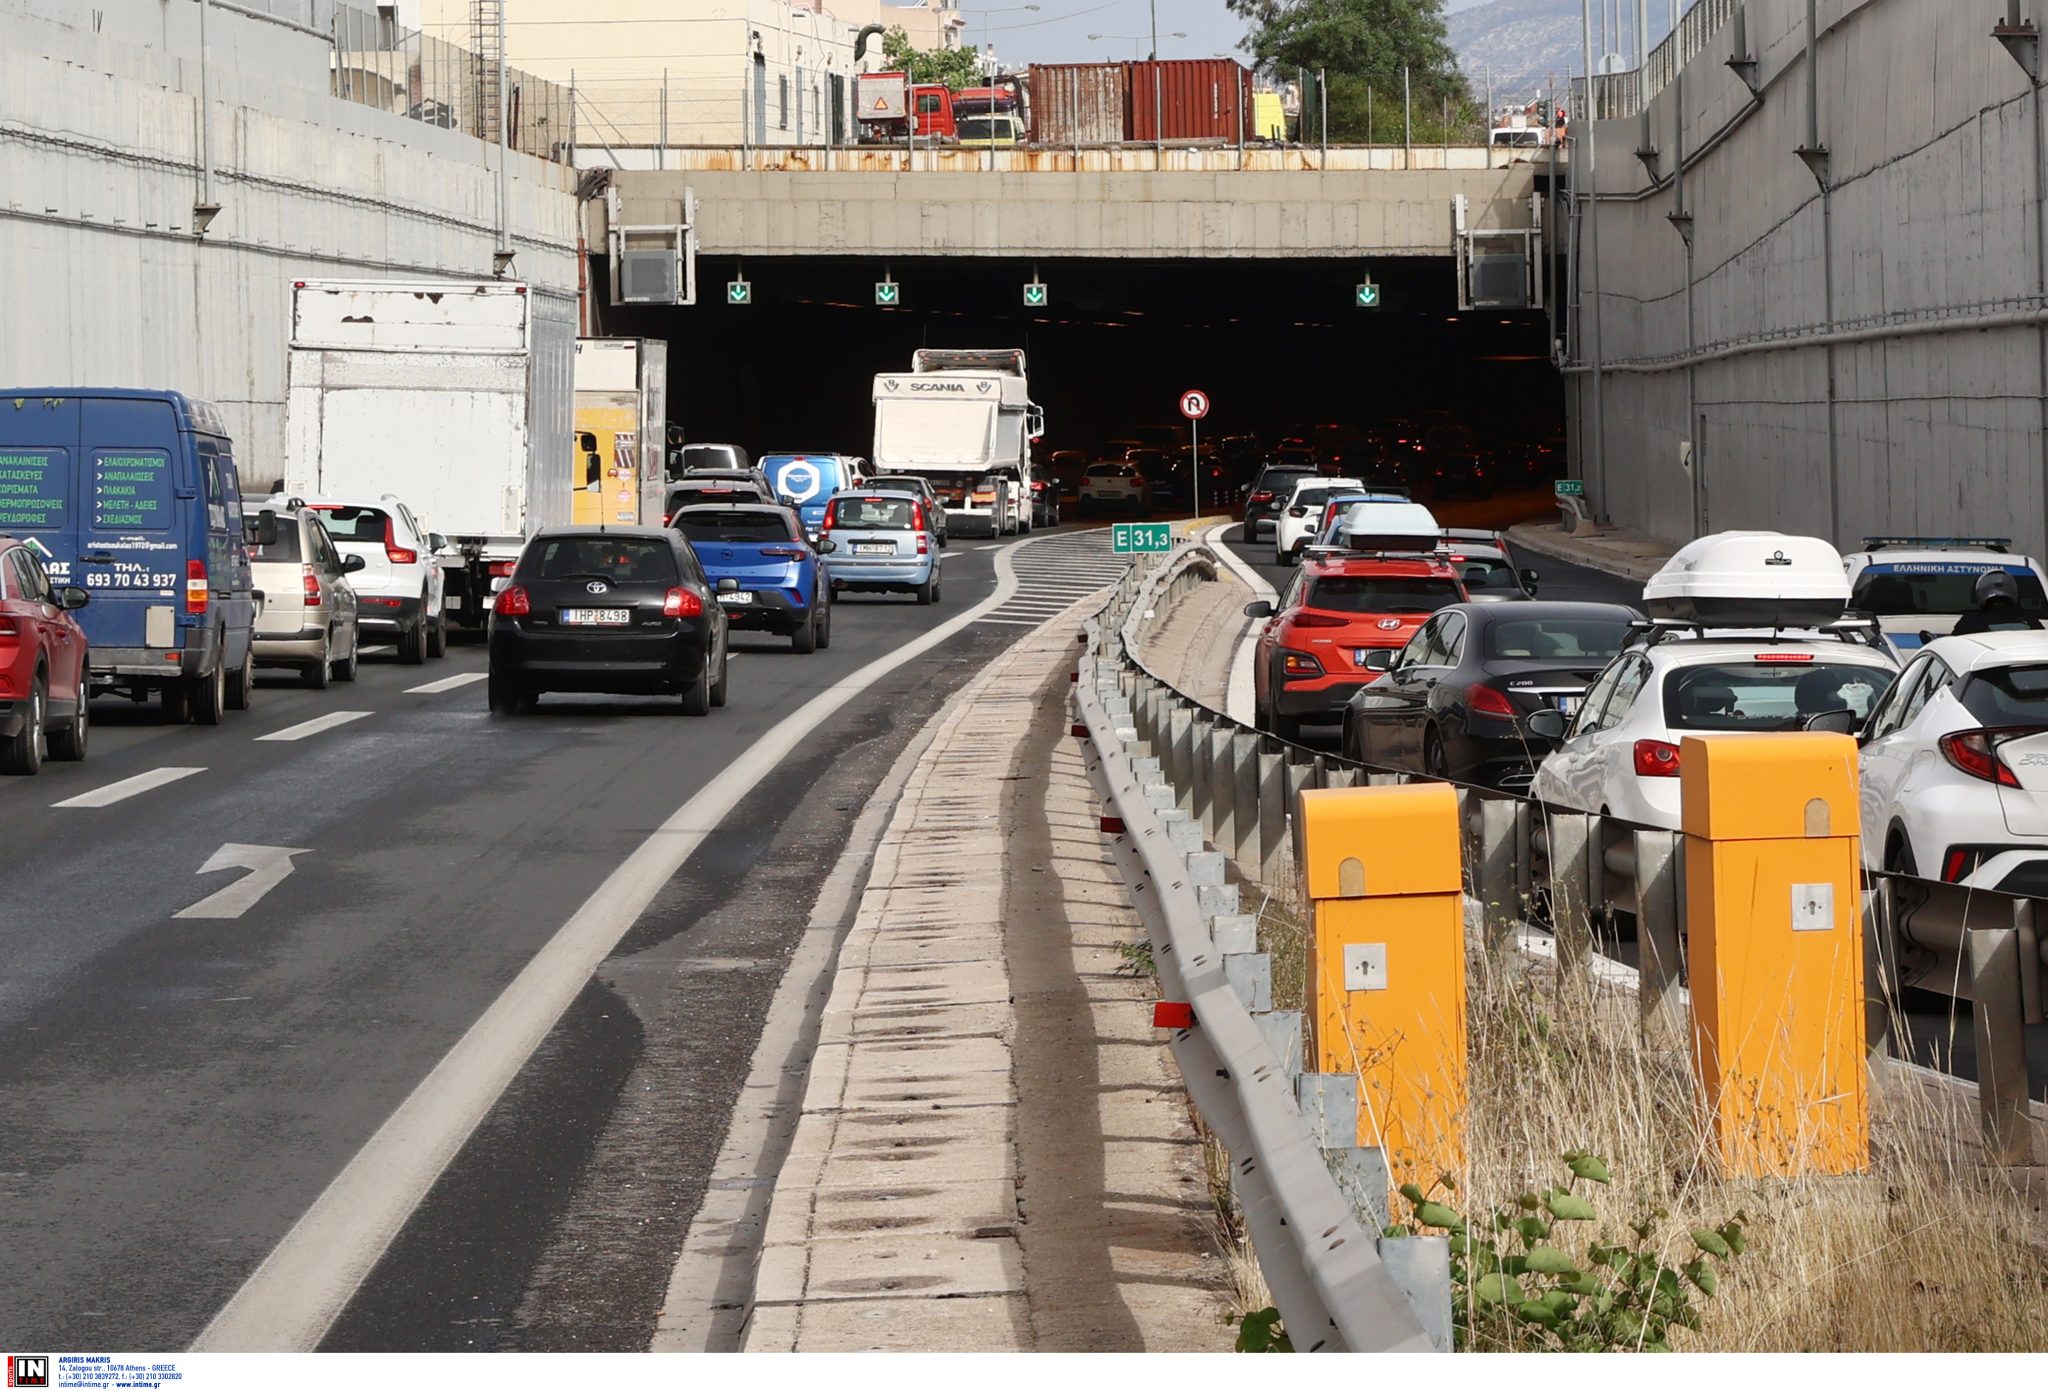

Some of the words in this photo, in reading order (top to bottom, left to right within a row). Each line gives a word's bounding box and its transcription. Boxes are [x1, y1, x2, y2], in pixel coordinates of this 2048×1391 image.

[910, 383, 965, 392] SCANIA
[103, 485, 135, 495] ΠΛΑΚΑΚΙΑ
[1557, 483, 1562, 491] E
[0, 498, 63, 509] ΕΡΜΟΠΡΟΣΟΨΕΙΣ
[103, 499, 129, 510] ΜΕΛΕΤΗ
[134, 500, 157, 510] ΑΔΕΙΕΣ
[102, 514, 142, 524] ΣΧΕΔΙΑΣΜΟΣ
[1117, 531, 1127, 546] E
[1134, 530, 1168, 549] 31,3
[41, 562, 70, 575] ΛΑΣ
[1893, 564, 1944, 573] ΕΛΛΗΝΙΚΗ
[49, 576, 71, 584] ΣΤΙΚΗ
[87, 574, 111, 587] 693
[114, 574, 130, 587] 70
[133, 574, 149, 587] 43
[152, 574, 177, 587] 937
